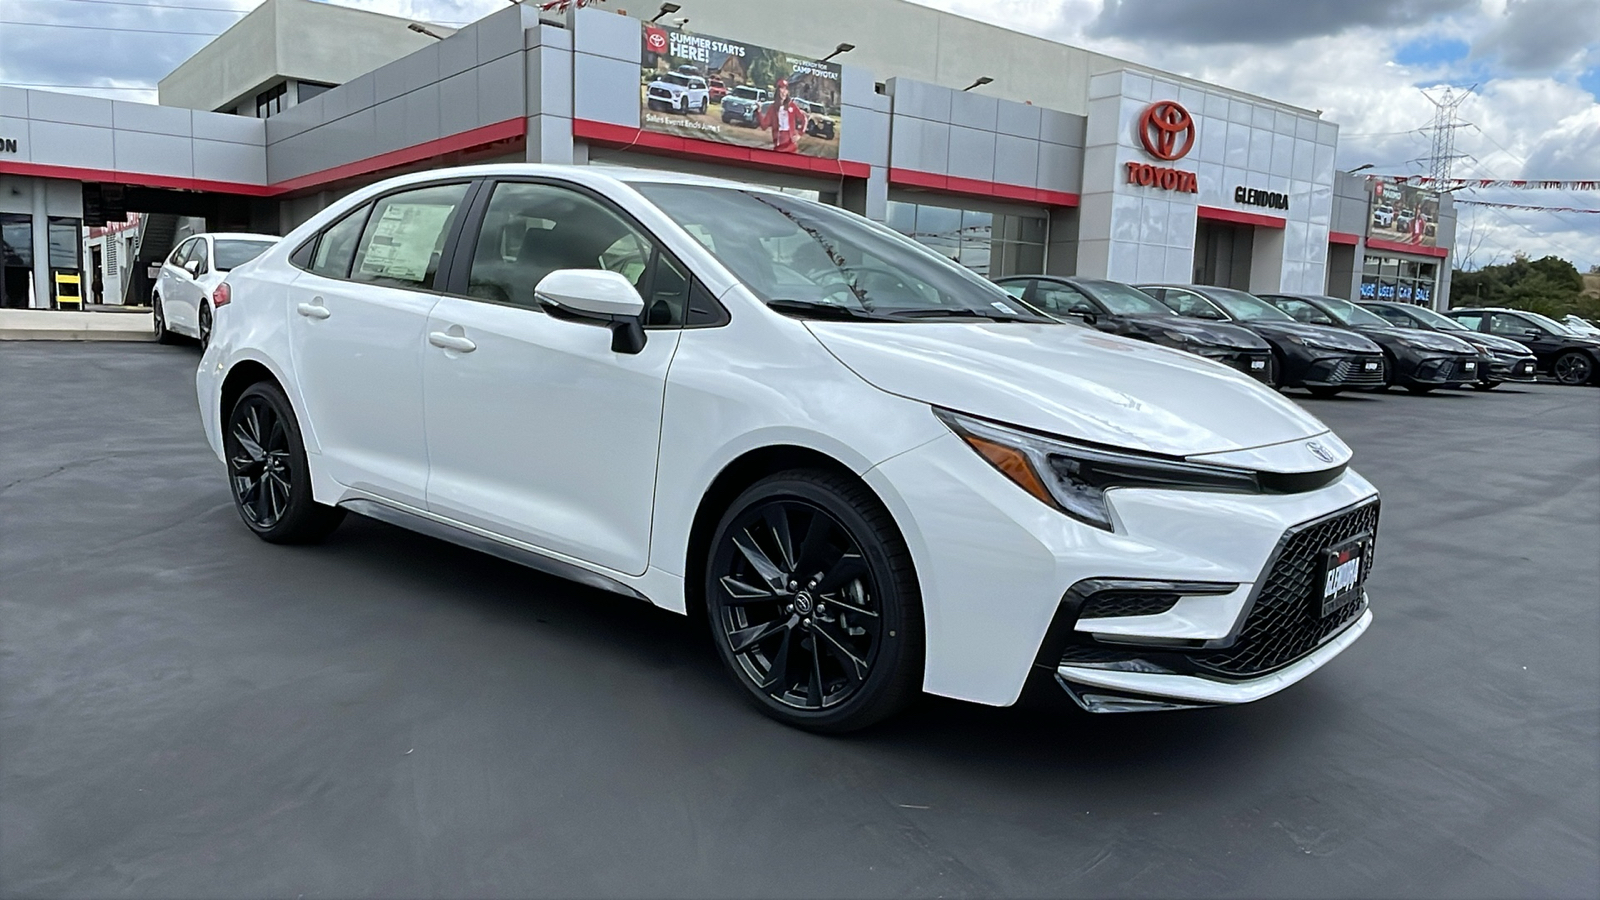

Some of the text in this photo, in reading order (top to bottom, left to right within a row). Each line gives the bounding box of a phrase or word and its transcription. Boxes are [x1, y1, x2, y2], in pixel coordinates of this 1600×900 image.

[669, 31, 746, 57] SUMMER STARTS
[669, 42, 710, 64] HERE!
[792, 64, 812, 75] CAMP
[645, 113, 664, 124] Sales
[664, 116, 685, 127] Event
[684, 119, 702, 129] Ends
[1126, 162, 1199, 194] TOYOTA
[1235, 186, 1289, 211] GLENDORA
[1378, 286, 1395, 298] USED
[1399, 287, 1412, 298] CAR
[1415, 288, 1430, 301] SALE
